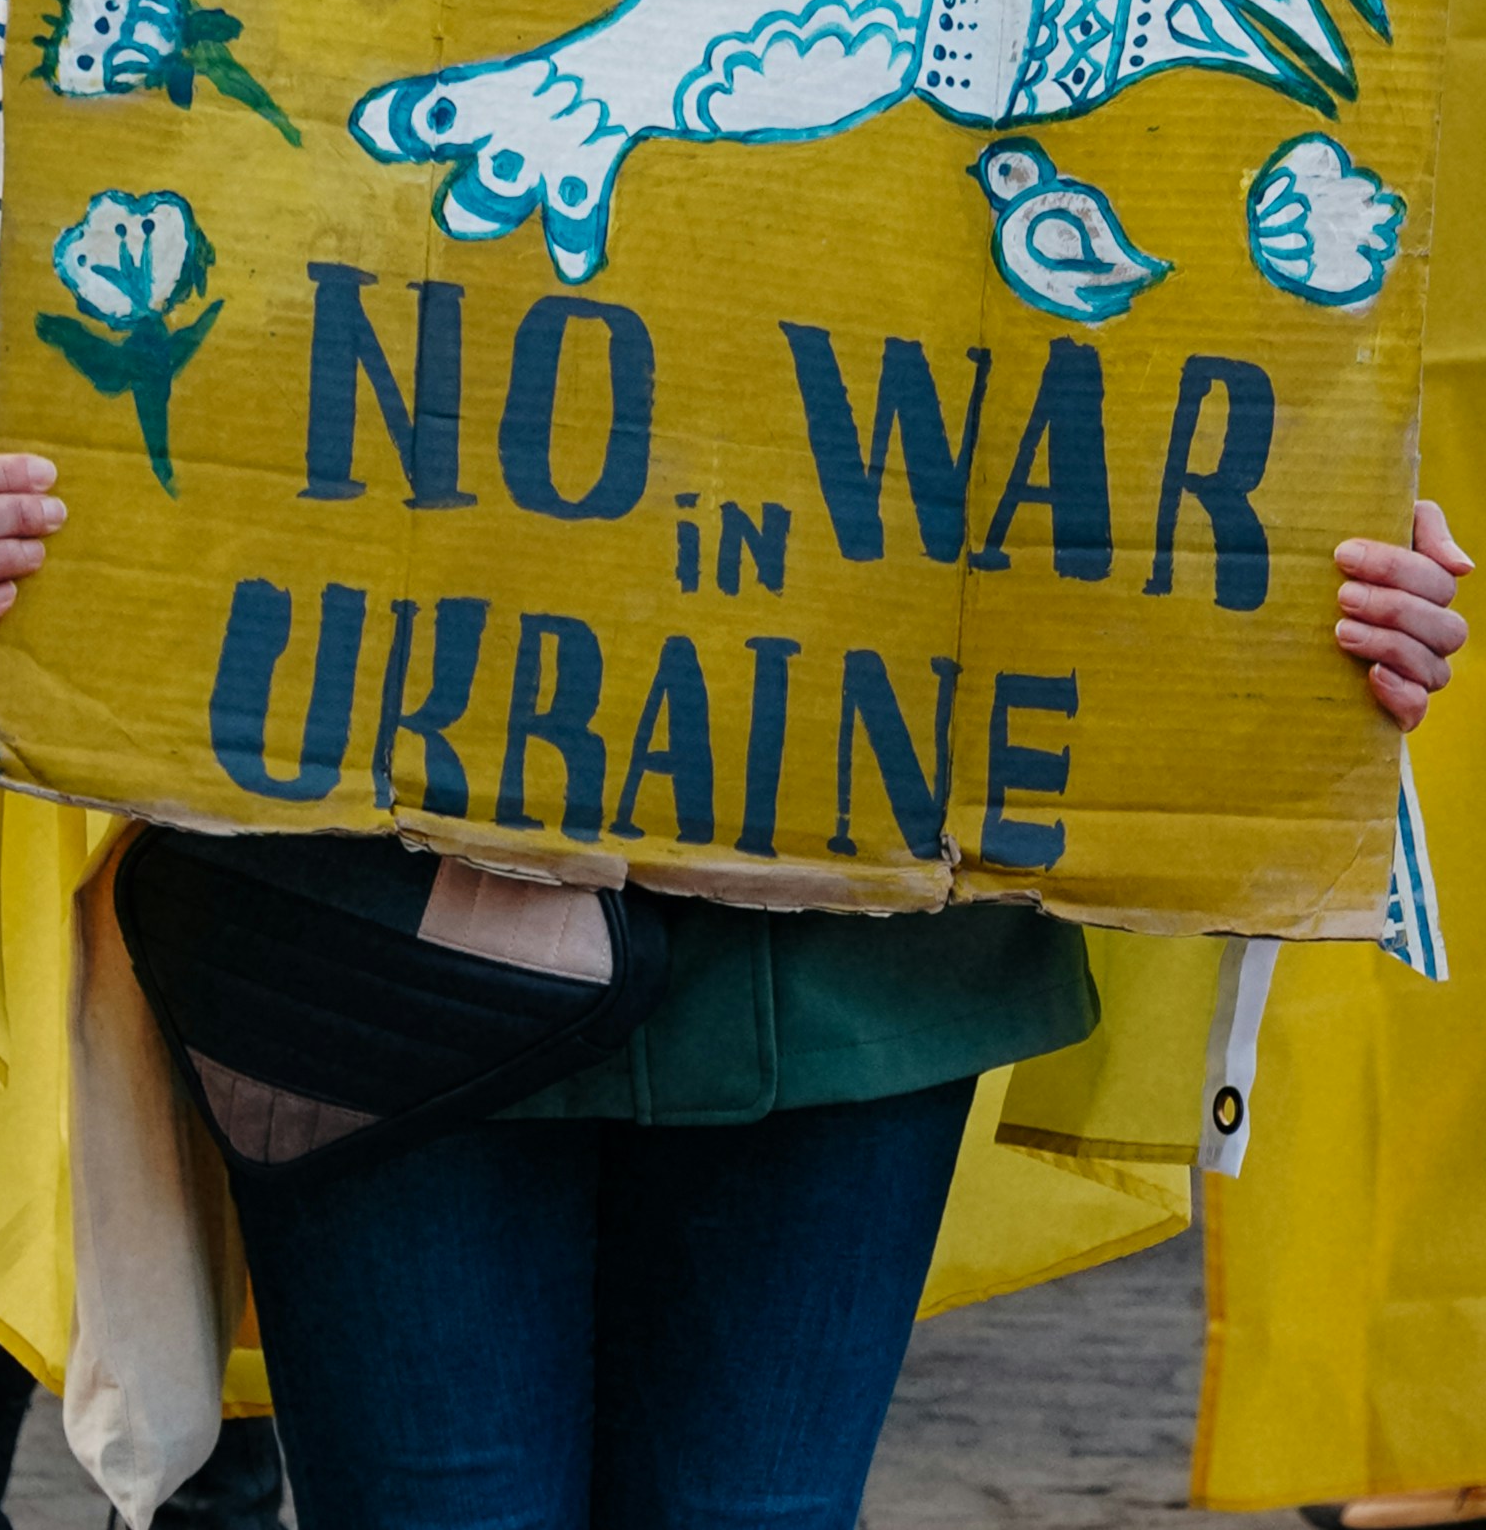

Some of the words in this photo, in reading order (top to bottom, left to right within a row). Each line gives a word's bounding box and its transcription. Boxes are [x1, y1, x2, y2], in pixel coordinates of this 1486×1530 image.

[298, 261, 659, 521] NO
[778, 321, 1277, 613] WAR
[209, 577, 1080, 872] UKRAINE
